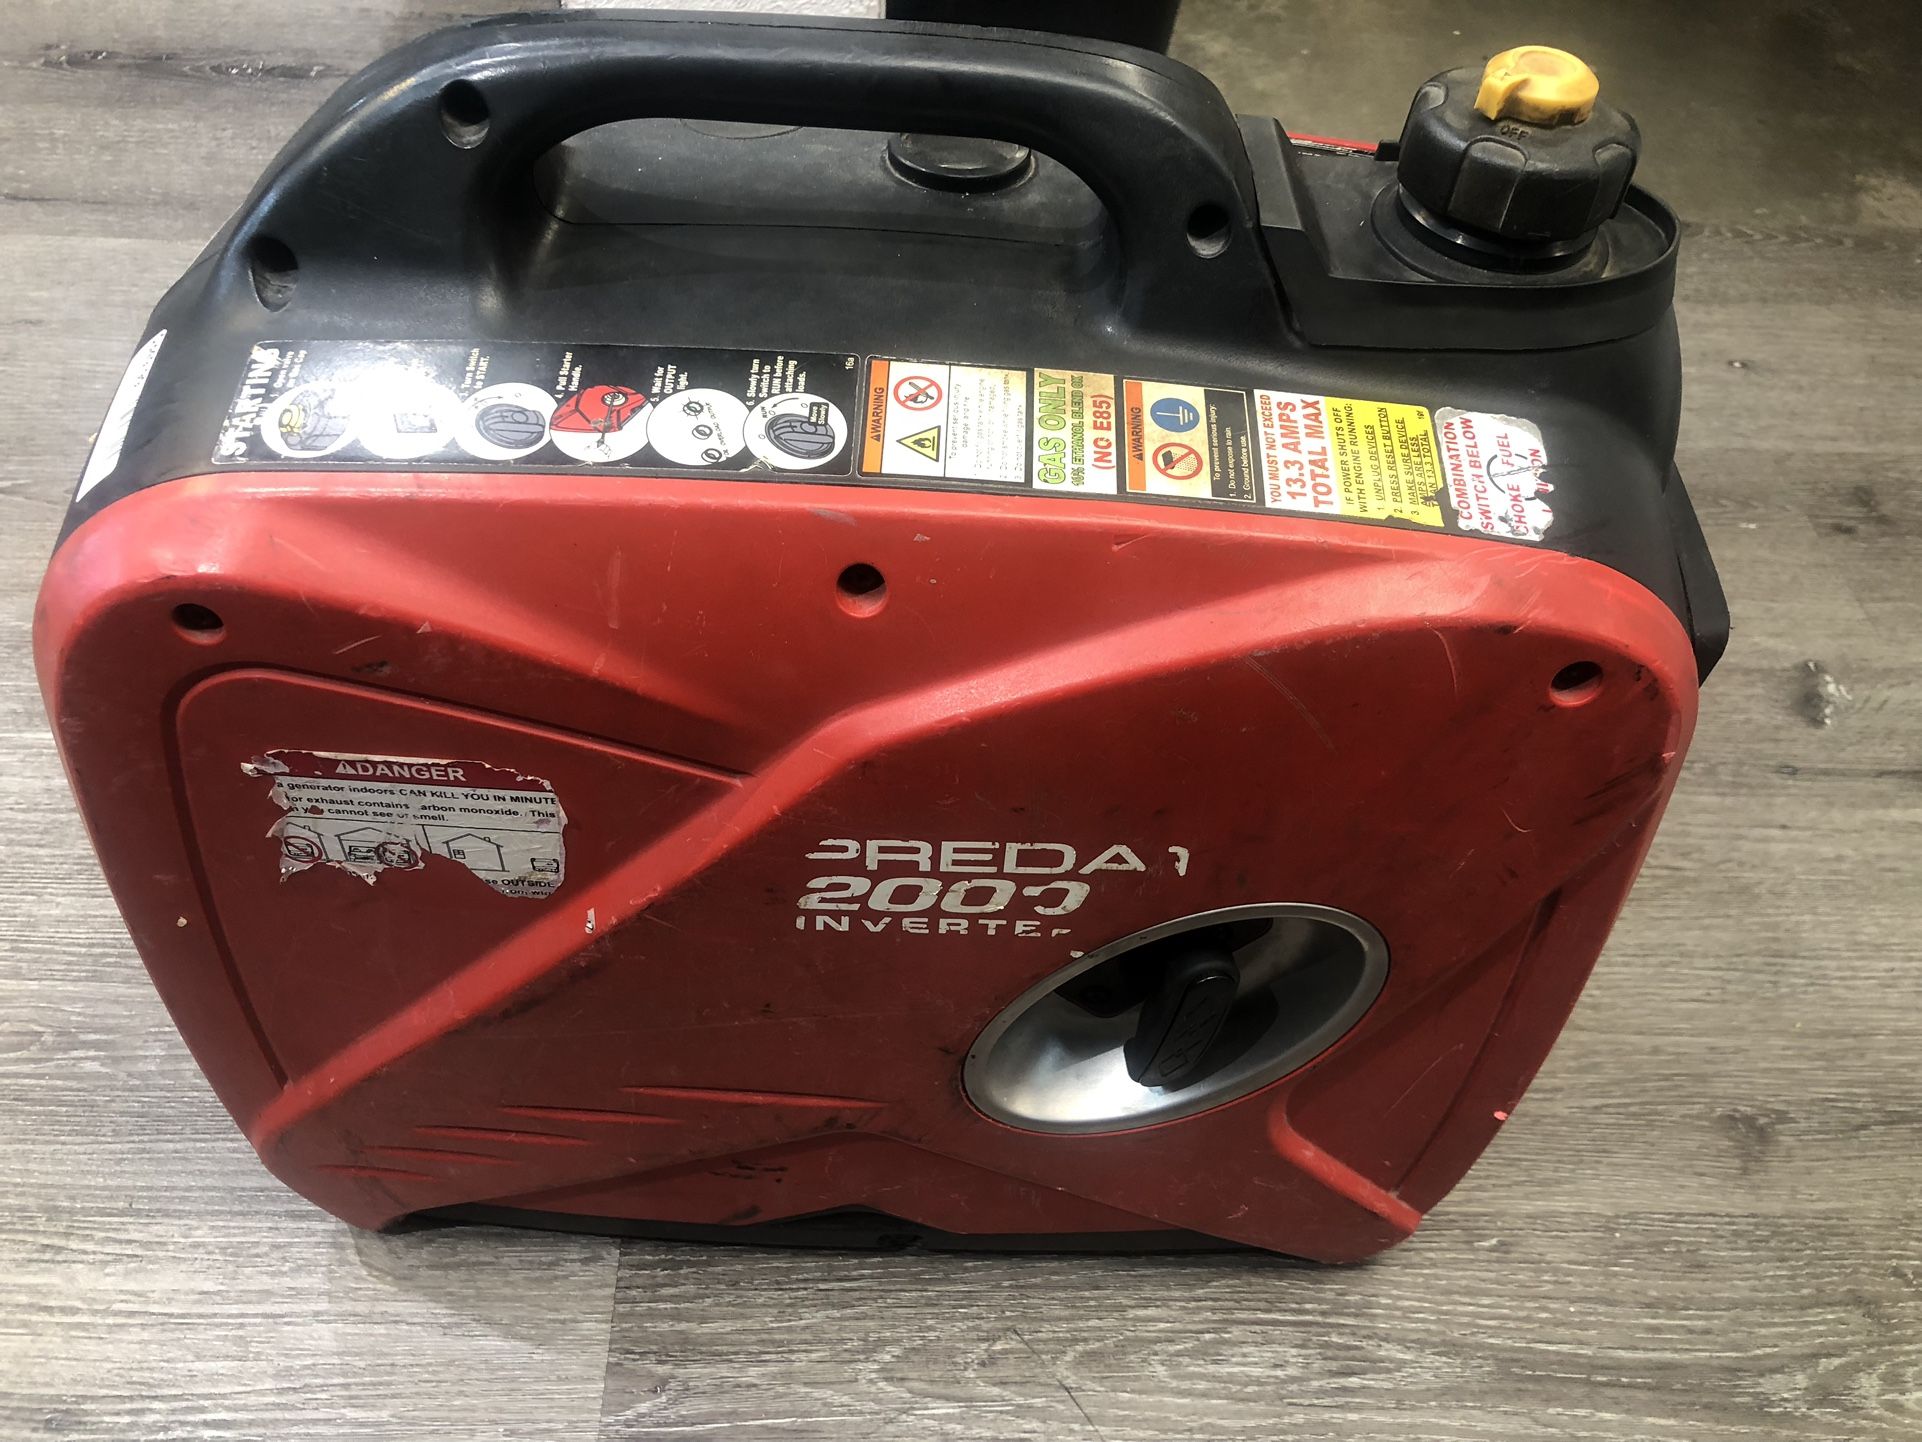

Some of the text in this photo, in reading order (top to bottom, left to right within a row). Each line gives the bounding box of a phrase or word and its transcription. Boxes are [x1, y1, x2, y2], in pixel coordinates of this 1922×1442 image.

[1500, 124, 1530, 140] OFF
[466, 348, 480, 370] Switch
[559, 352, 572, 376] Starter
[654, 367, 664, 376] for
[750, 359, 759, 373] turn
[461, 372, 473, 388] Turn
[556, 377, 567, 390] Pull
[568, 365, 582, 391] Handle.
[652, 378, 662, 393] Wait
[664, 364, 676, 394] OUTPUT
[677, 372, 688, 389] light.
[747, 374, 759, 397] Slowly
[760, 374, 770, 397] Switch
[771, 356, 783, 394] RUN before
[784, 361, 797, 392] attaching
[796, 371, 806, 392] loads.
[1071, 375, 1083, 388] OK
[818, 405, 827, 425] Slowly
[871, 387, 884, 433] WARNING
[1071, 390, 1083, 419] BLEND
[1209, 404, 1218, 422] injury:
[1038, 372, 1066, 484] GAS ONLY
[1090, 394, 1115, 470] (NO E85)
[1131, 407, 1142, 452] WARNING
[1210, 424, 1218, 446] serious
[1377, 407, 1391, 440] BUTTON
[1395, 418, 1409, 450] DEVICE
[1071, 421, 1084, 465] ETHANOL
[1260, 394, 1281, 503] YOU MUST NOT EXCEED
[1277, 401, 1307, 500] 13.3 AMPS
[1300, 398, 1334, 508] TOTAL MAX
[1364, 425, 1378, 461] DEVICES
[1409, 435, 1421, 458] LESS
[1496, 433, 1515, 467] FUEL
[1212, 448, 1221, 471] prevent
[1226, 447, 1235, 468] expose
[1332, 407, 1354, 505] IF POWER SHUTS OFF
[1344, 403, 1368, 513] WITH ENGINE RUNNING:
[1383, 443, 1396, 470] RESET
[1401, 453, 1414, 476] SURE
[1419, 430, 1439, 507] TAN 13.3 TOTAL.
[1227, 469, 1235, 478] not
[1242, 468, 1250, 490] Ground
[1414, 461, 1425, 478] ARE
[1443, 422, 1473, 520] COMBINATION
[1460, 417, 1494, 530] SWITCH BELOW
[1228, 481, 1235, 489] Do
[1370, 464, 1384, 501] UNPLUG
[1389, 474, 1402, 503] PRESS
[1406, 479, 1418, 505] MAKE
[354, 762, 466, 781] DANGER
[287, 782, 344, 792] generator
[349, 785, 395, 795] indoors
[399, 789, 427, 797] CAN
[431, 791, 458, 799] KILL
[462, 792, 490, 801] YOU
[510, 796, 556, 805] MINUTE
[307, 797, 354, 806] exhaust
[358, 800, 410, 810] contains
[420, 803, 455, 812] arbon
[459, 807, 522, 816] monoxide.
[529, 810, 556, 818] This
[797, 876, 1091, 915] 2000
